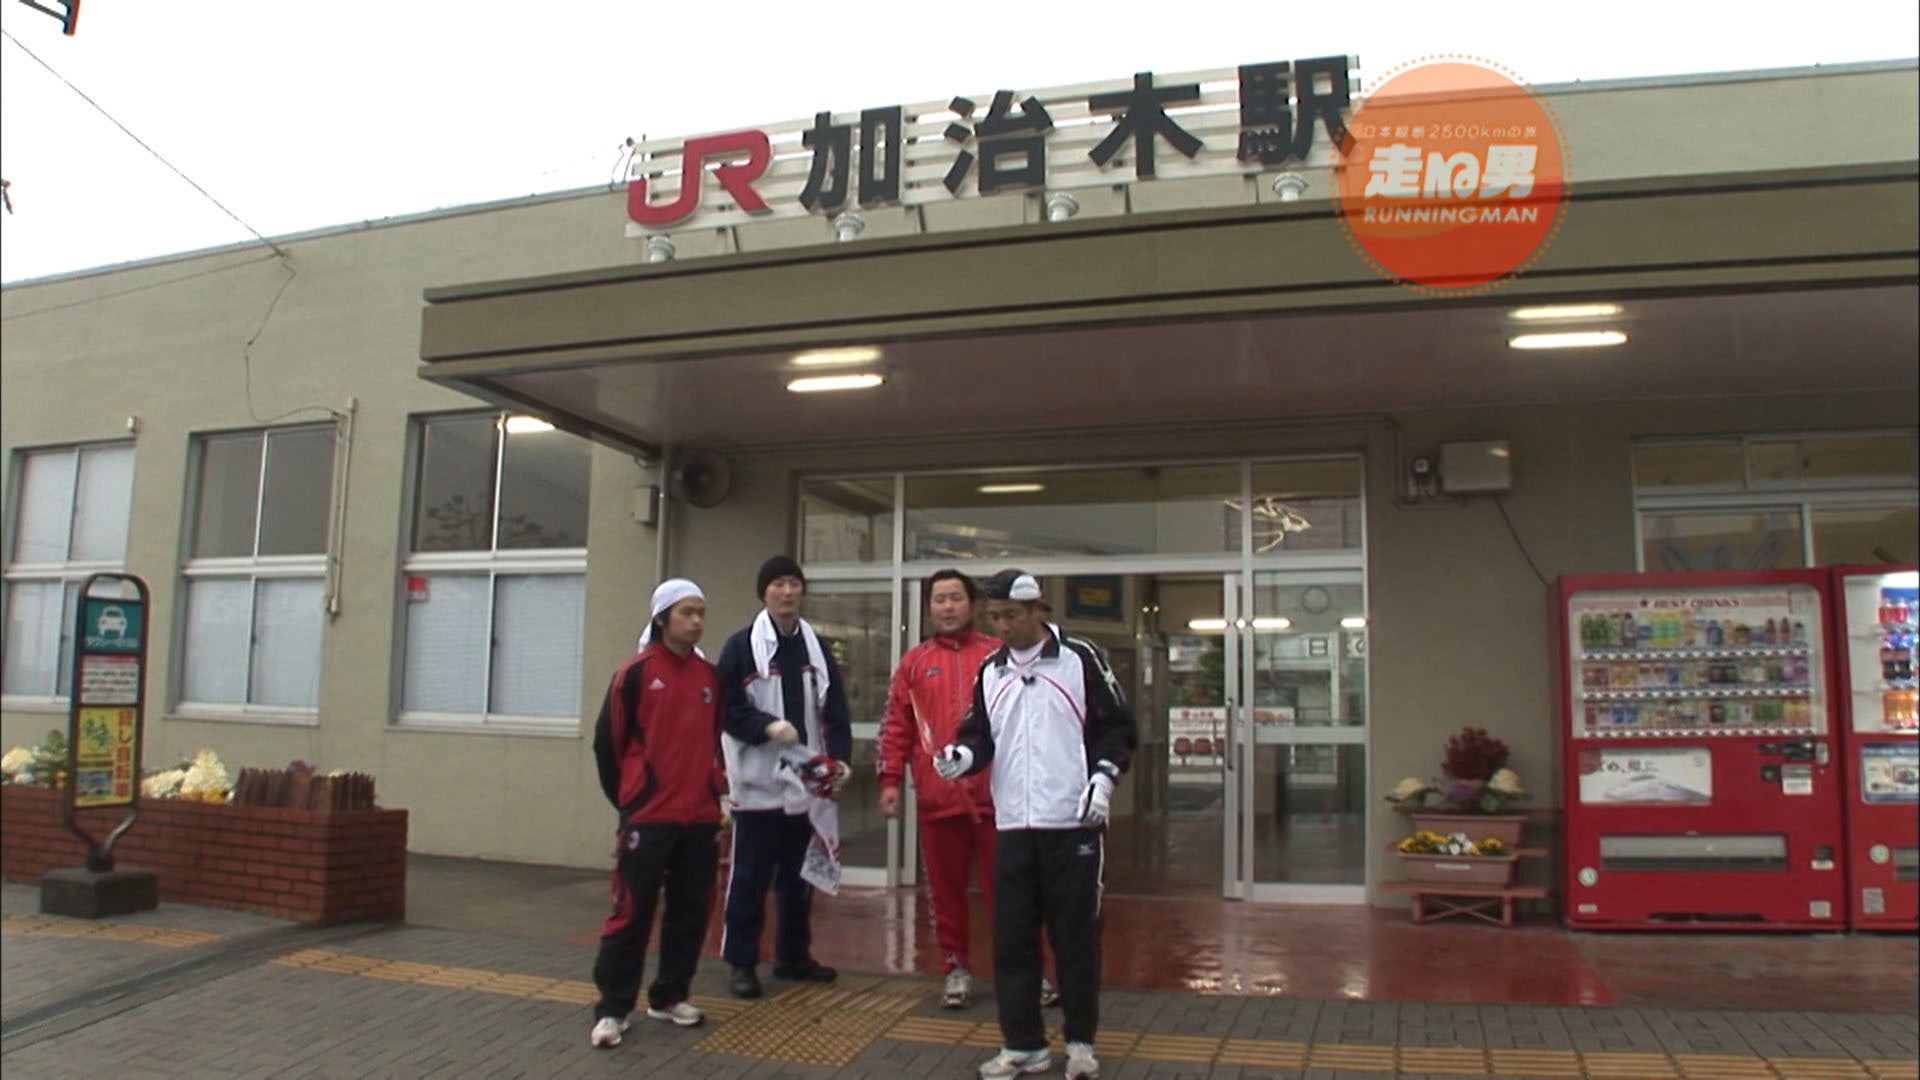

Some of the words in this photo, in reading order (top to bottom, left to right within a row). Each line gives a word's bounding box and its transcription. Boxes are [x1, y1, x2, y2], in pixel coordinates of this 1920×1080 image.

[627, 130, 771, 226] JR
[799, 54, 1356, 213] 加治木駅
